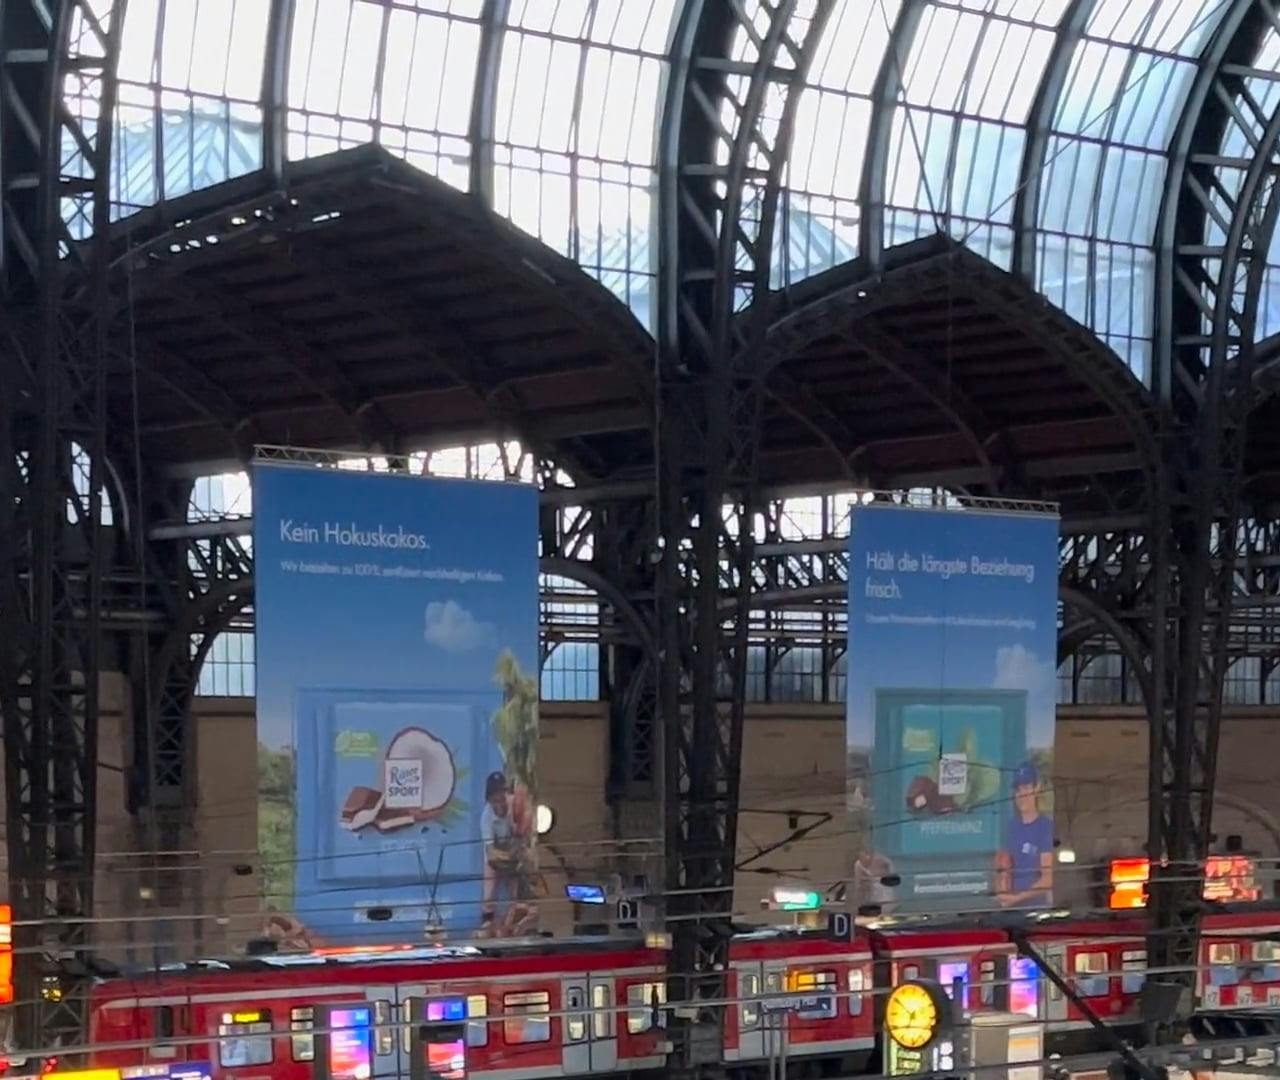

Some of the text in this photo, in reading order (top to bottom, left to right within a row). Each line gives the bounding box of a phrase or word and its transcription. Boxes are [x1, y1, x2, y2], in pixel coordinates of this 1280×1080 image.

[279, 519, 431, 550] Kein Hokuskokos.
[866, 550, 1035, 583] Hält die längste Beziehung
[865, 576, 902, 600] frisch.
[388, 786, 420, 797] SPORT
[834, 913, 848, 937] D
